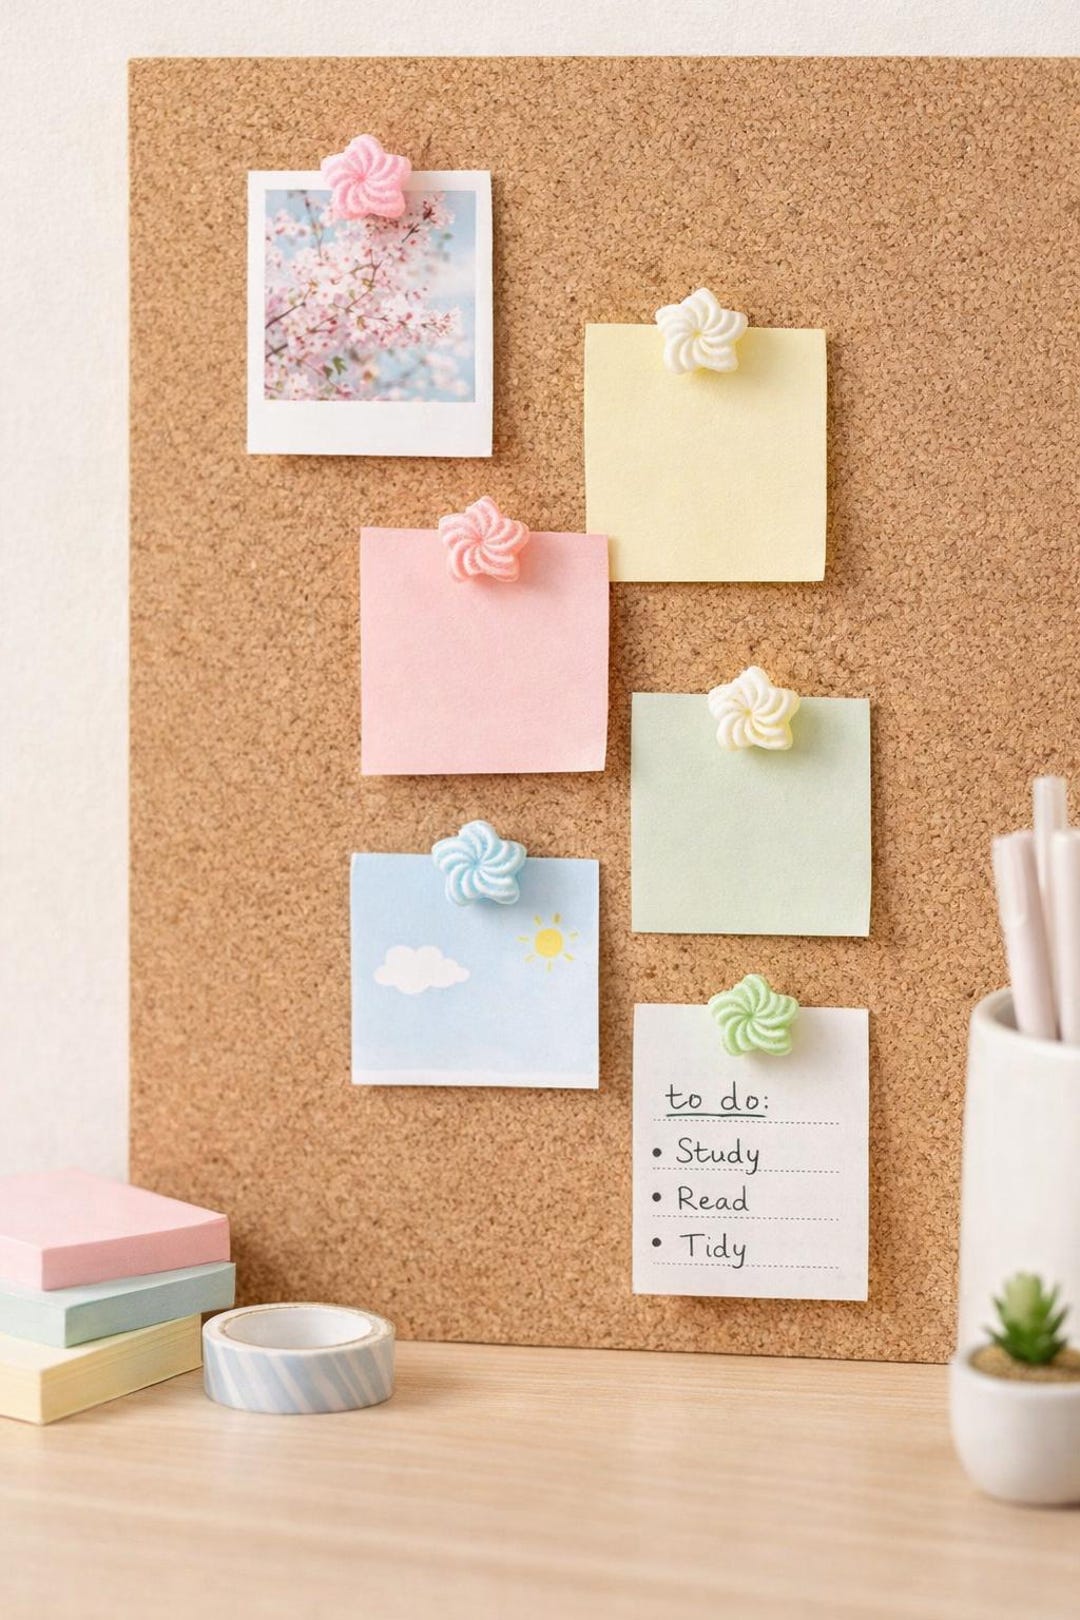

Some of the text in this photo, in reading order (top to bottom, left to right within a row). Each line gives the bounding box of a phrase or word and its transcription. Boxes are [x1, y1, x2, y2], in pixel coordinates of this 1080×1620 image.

[665, 1081, 769, 1111] to do:
[676, 1137, 760, 1175] Study
[678, 1185, 749, 1211] Read
[679, 1233, 746, 1269] Tidy
